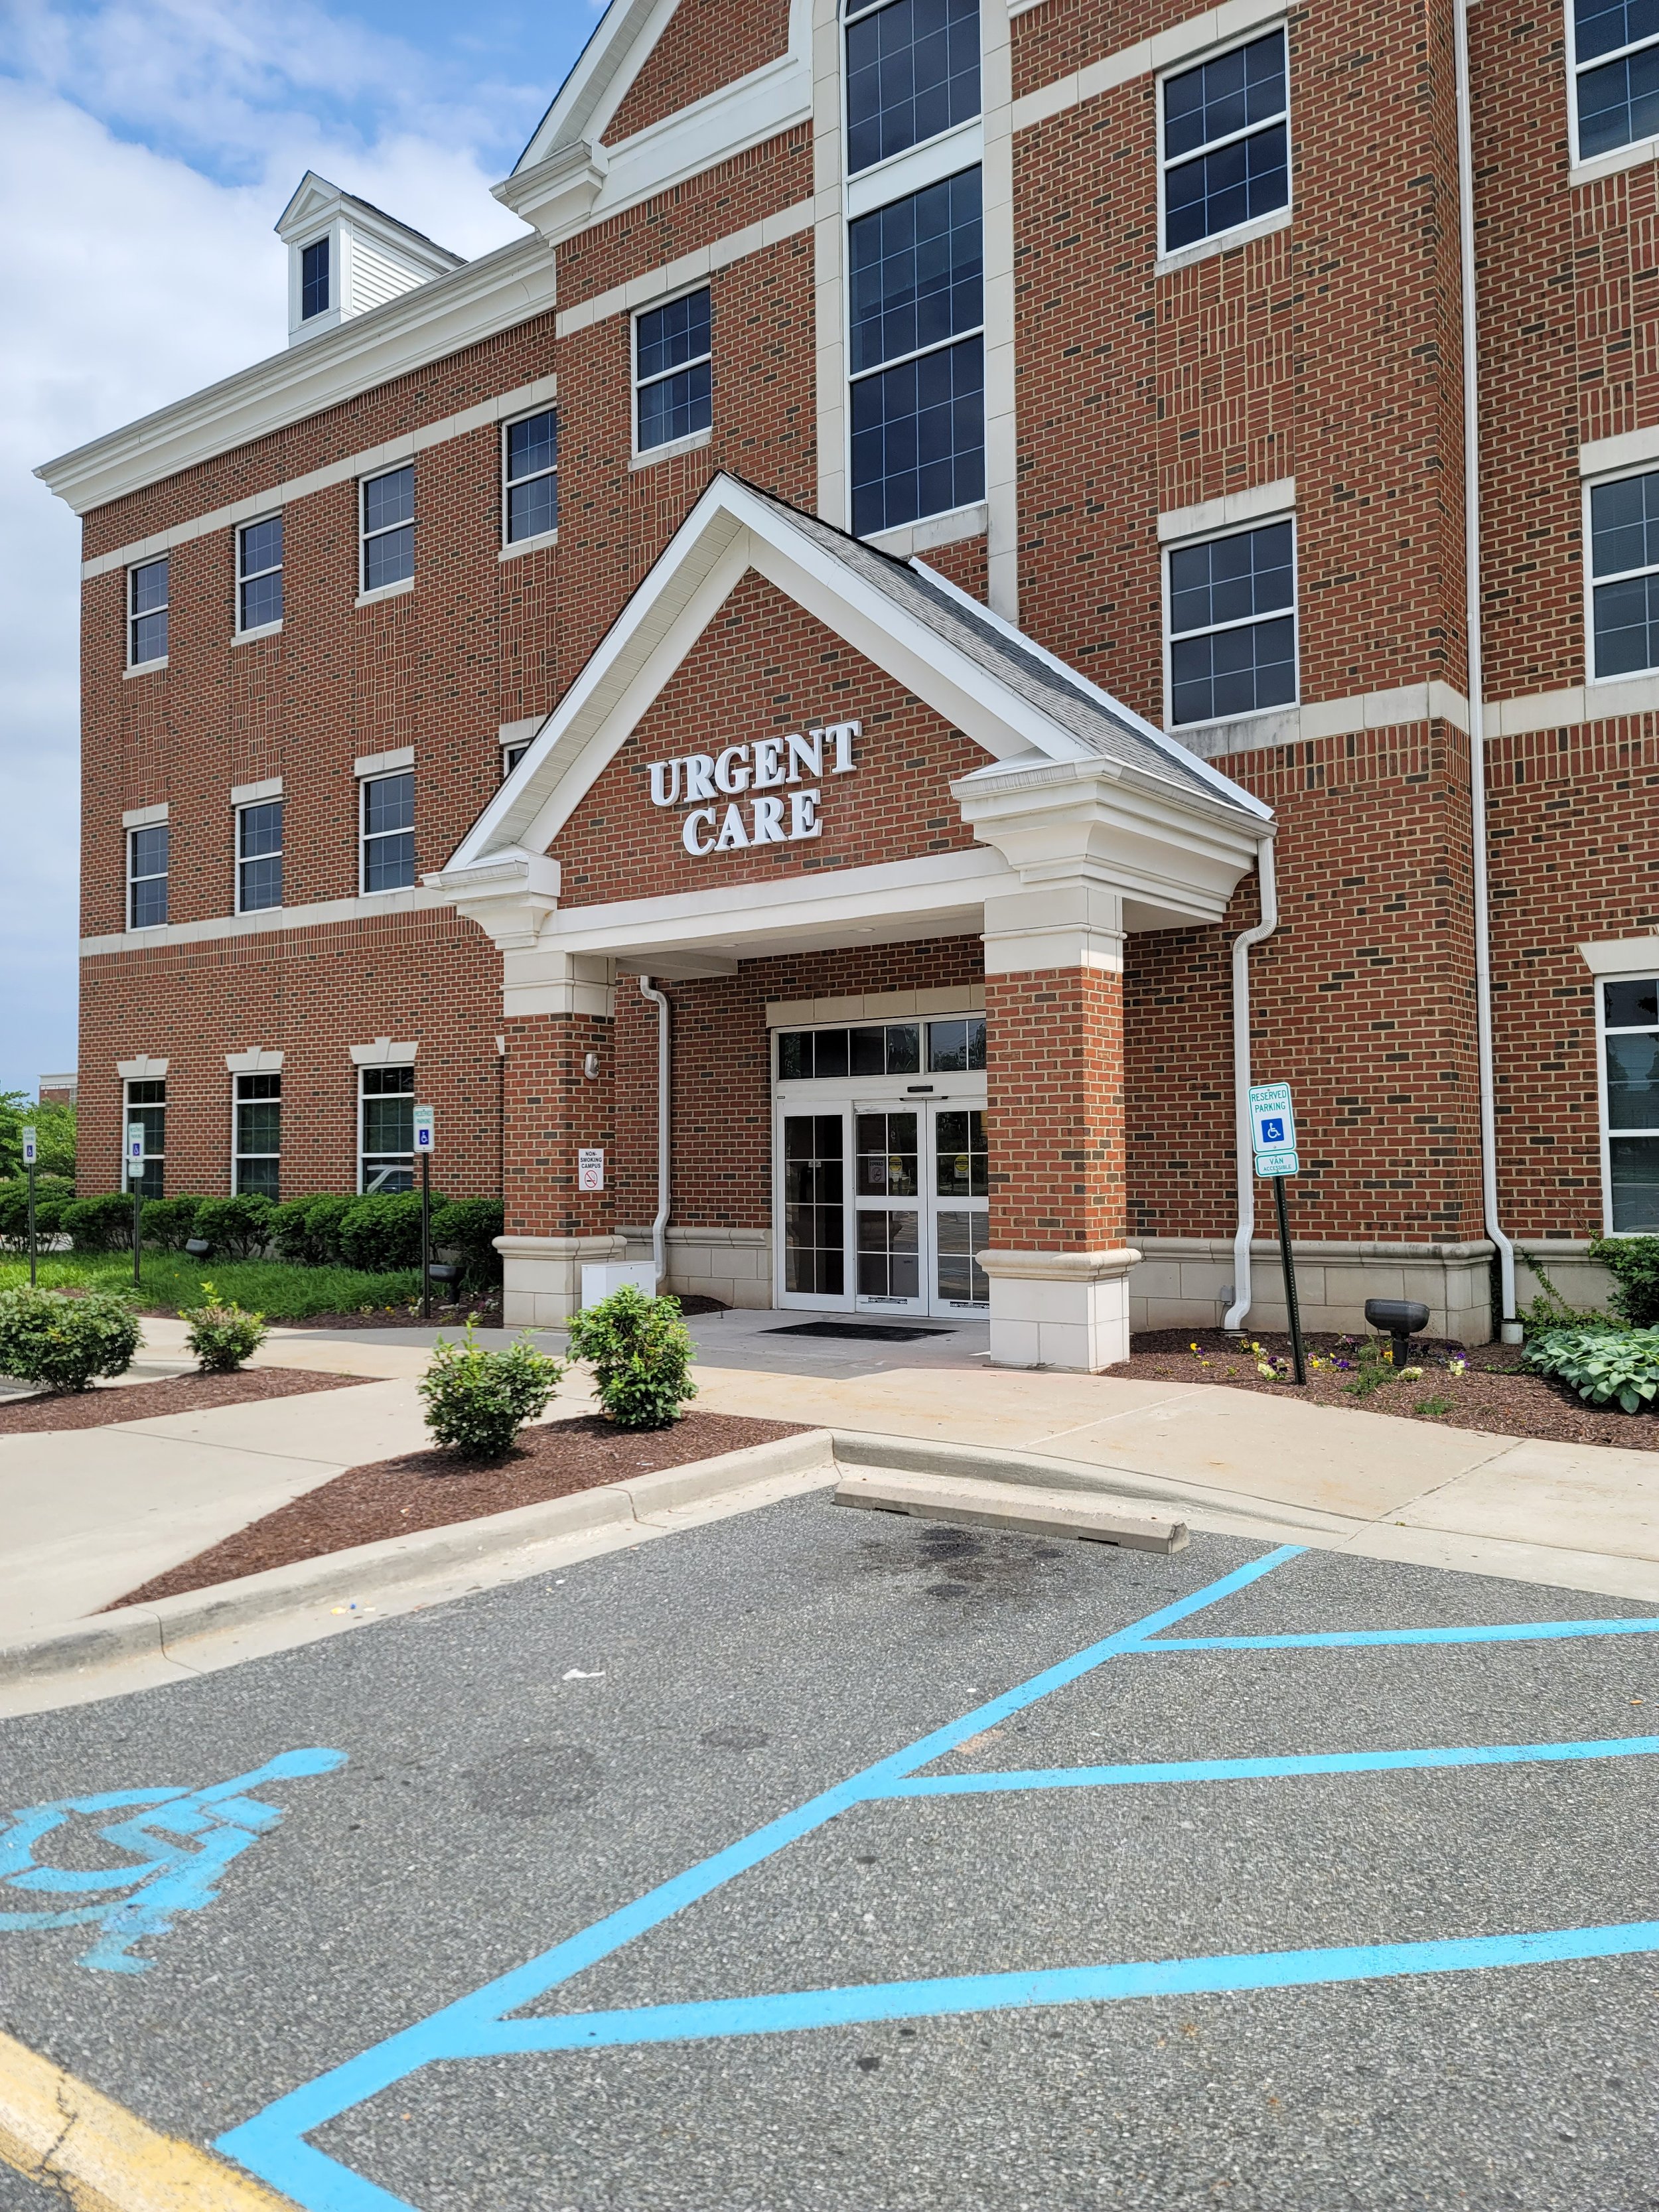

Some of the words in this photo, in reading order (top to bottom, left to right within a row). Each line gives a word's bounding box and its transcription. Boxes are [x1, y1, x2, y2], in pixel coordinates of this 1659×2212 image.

[647, 720, 862, 807] URGENT
[683, 788, 823, 856] CARE
[1251, 1090, 1287, 1102] RESERVED
[1255, 1101, 1286, 1113] PARKING
